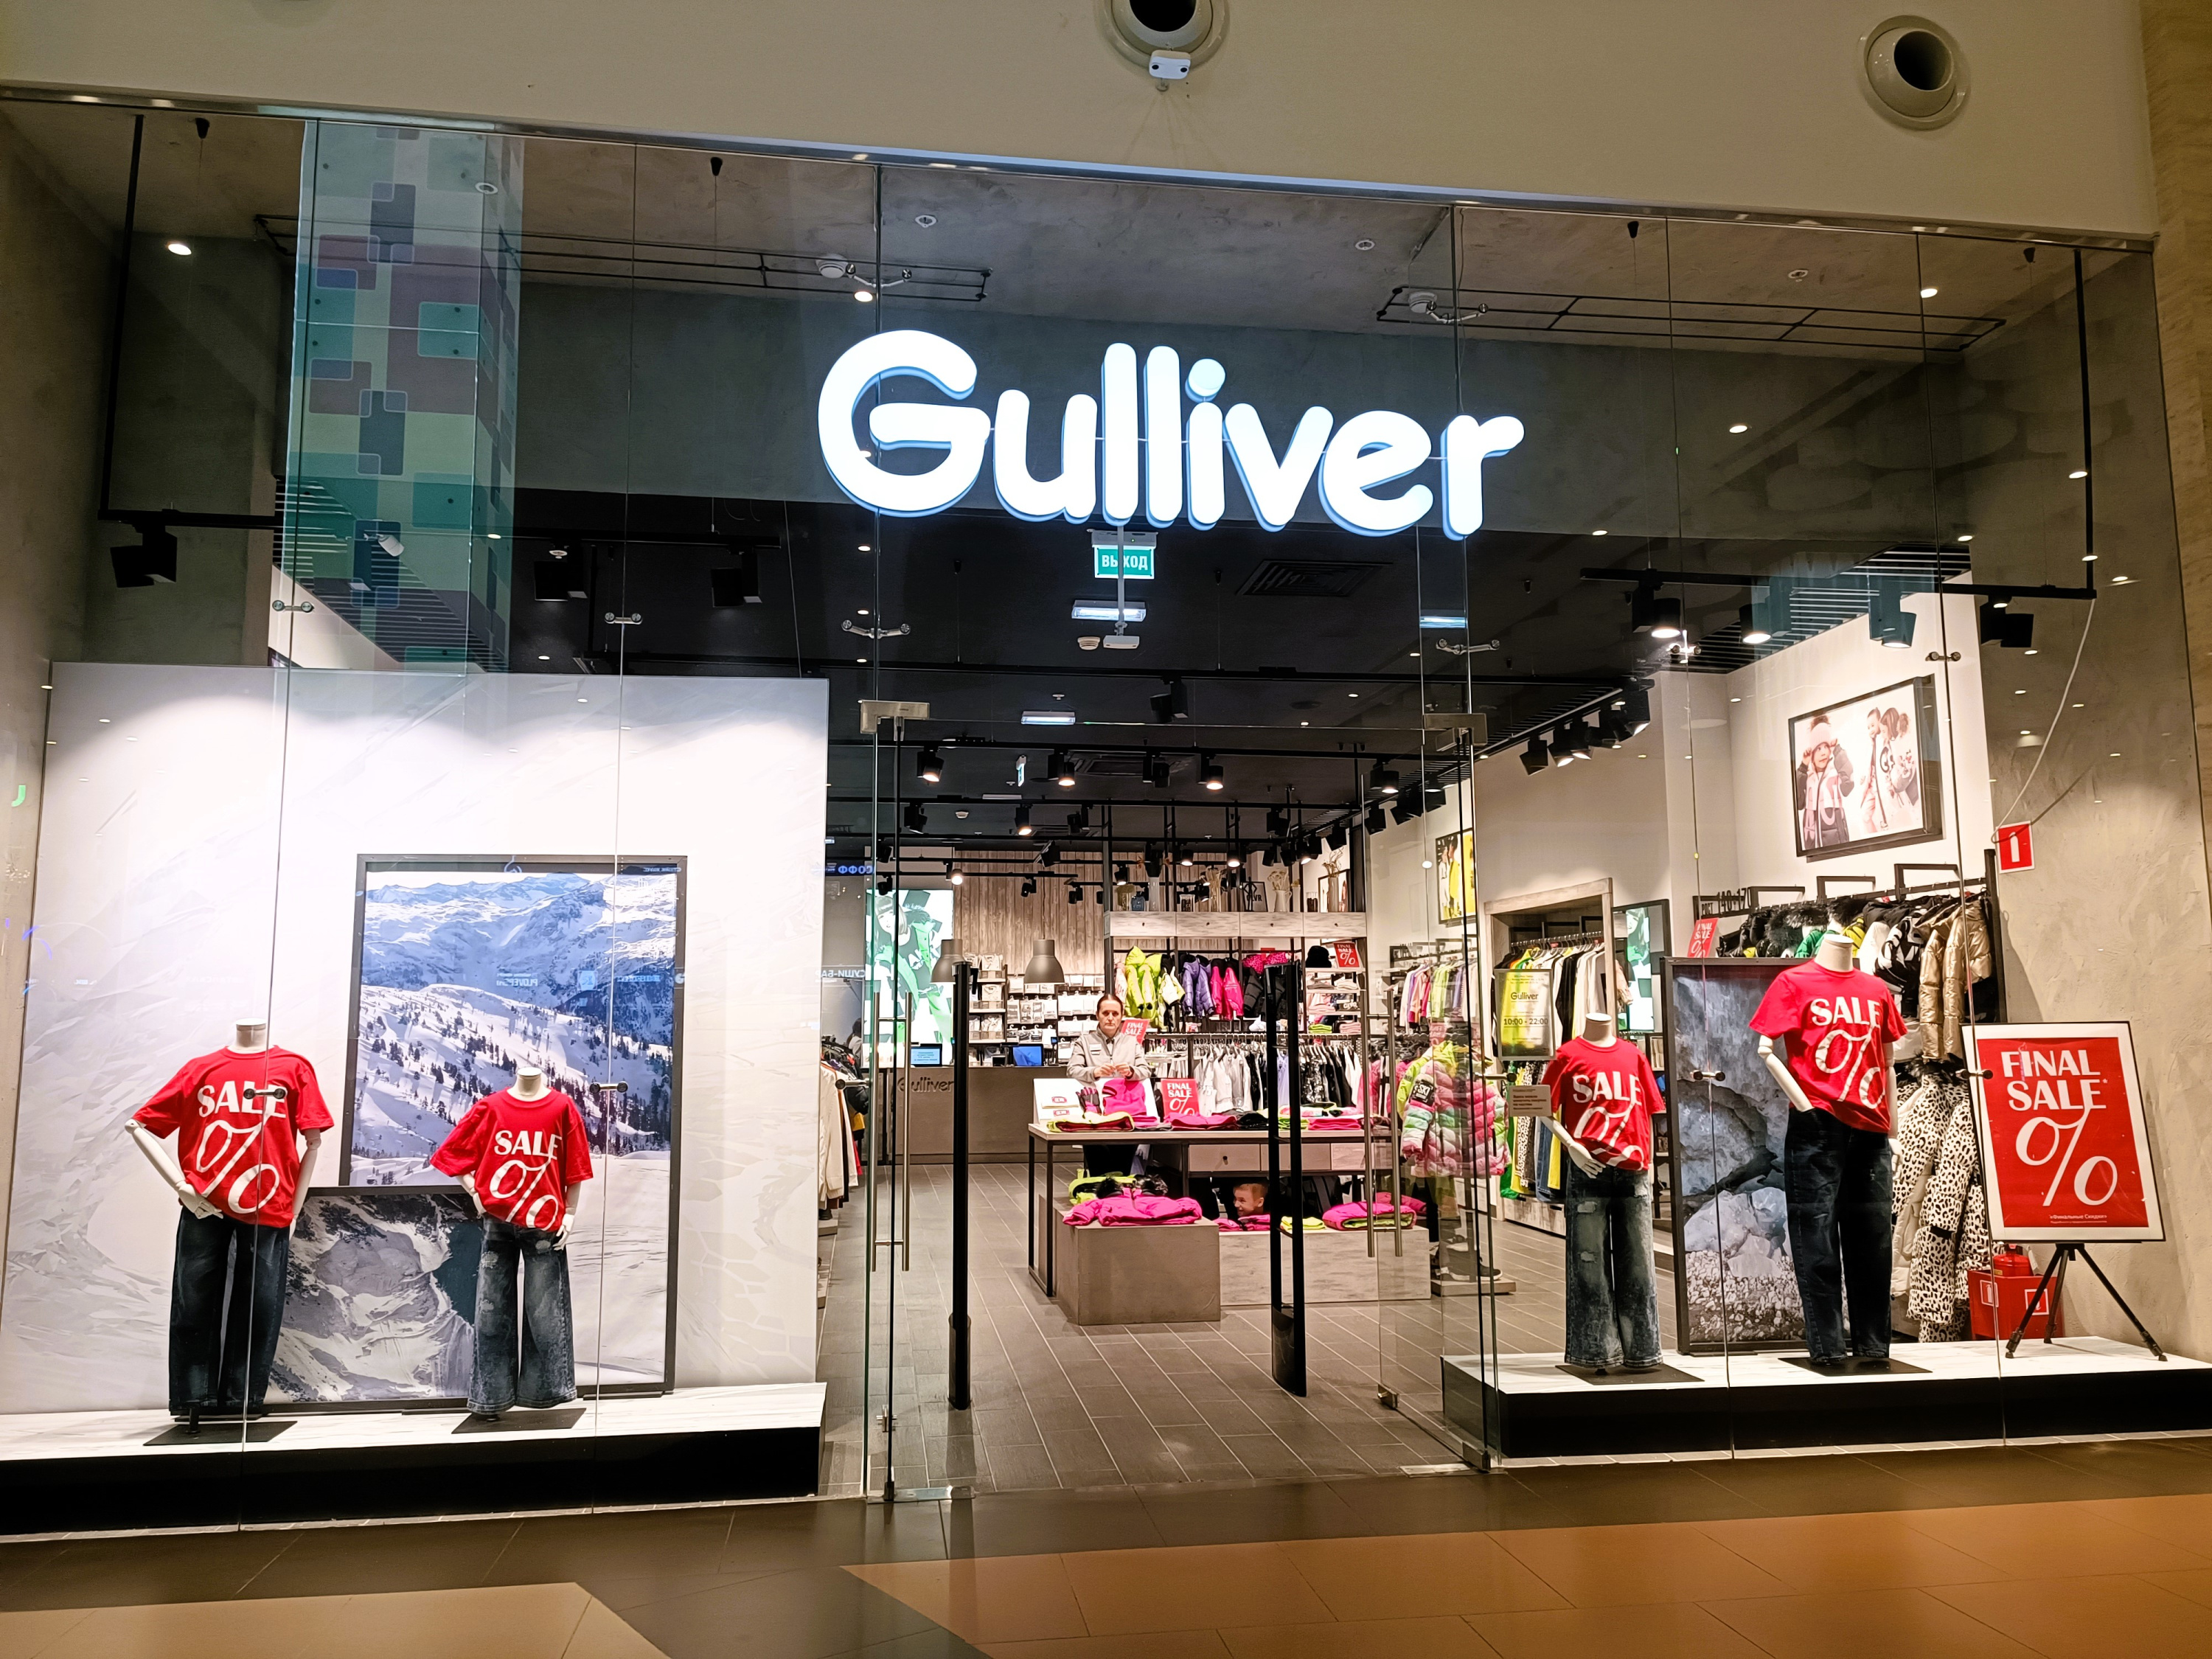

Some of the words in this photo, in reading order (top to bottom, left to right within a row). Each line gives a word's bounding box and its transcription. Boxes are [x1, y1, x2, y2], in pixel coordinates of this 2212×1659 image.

[818, 330, 1525, 540] Gulliver
[1102, 554, 1148, 571] ВЫХОД
[1510, 992, 1539, 1000] Gulliver
[1503, 1018, 1523, 1026] 10:00
[1809, 996, 1882, 1029] SALE
[2001, 1049, 2101, 1078] FINAL
[897, 1077, 954, 1092] Gulliver
[1168, 1089, 1193, 1098] SALE
[1572, 1071, 1643, 1107] SALE
[197, 1080, 288, 1119] SALE
[493, 1130, 563, 1161] SALE
